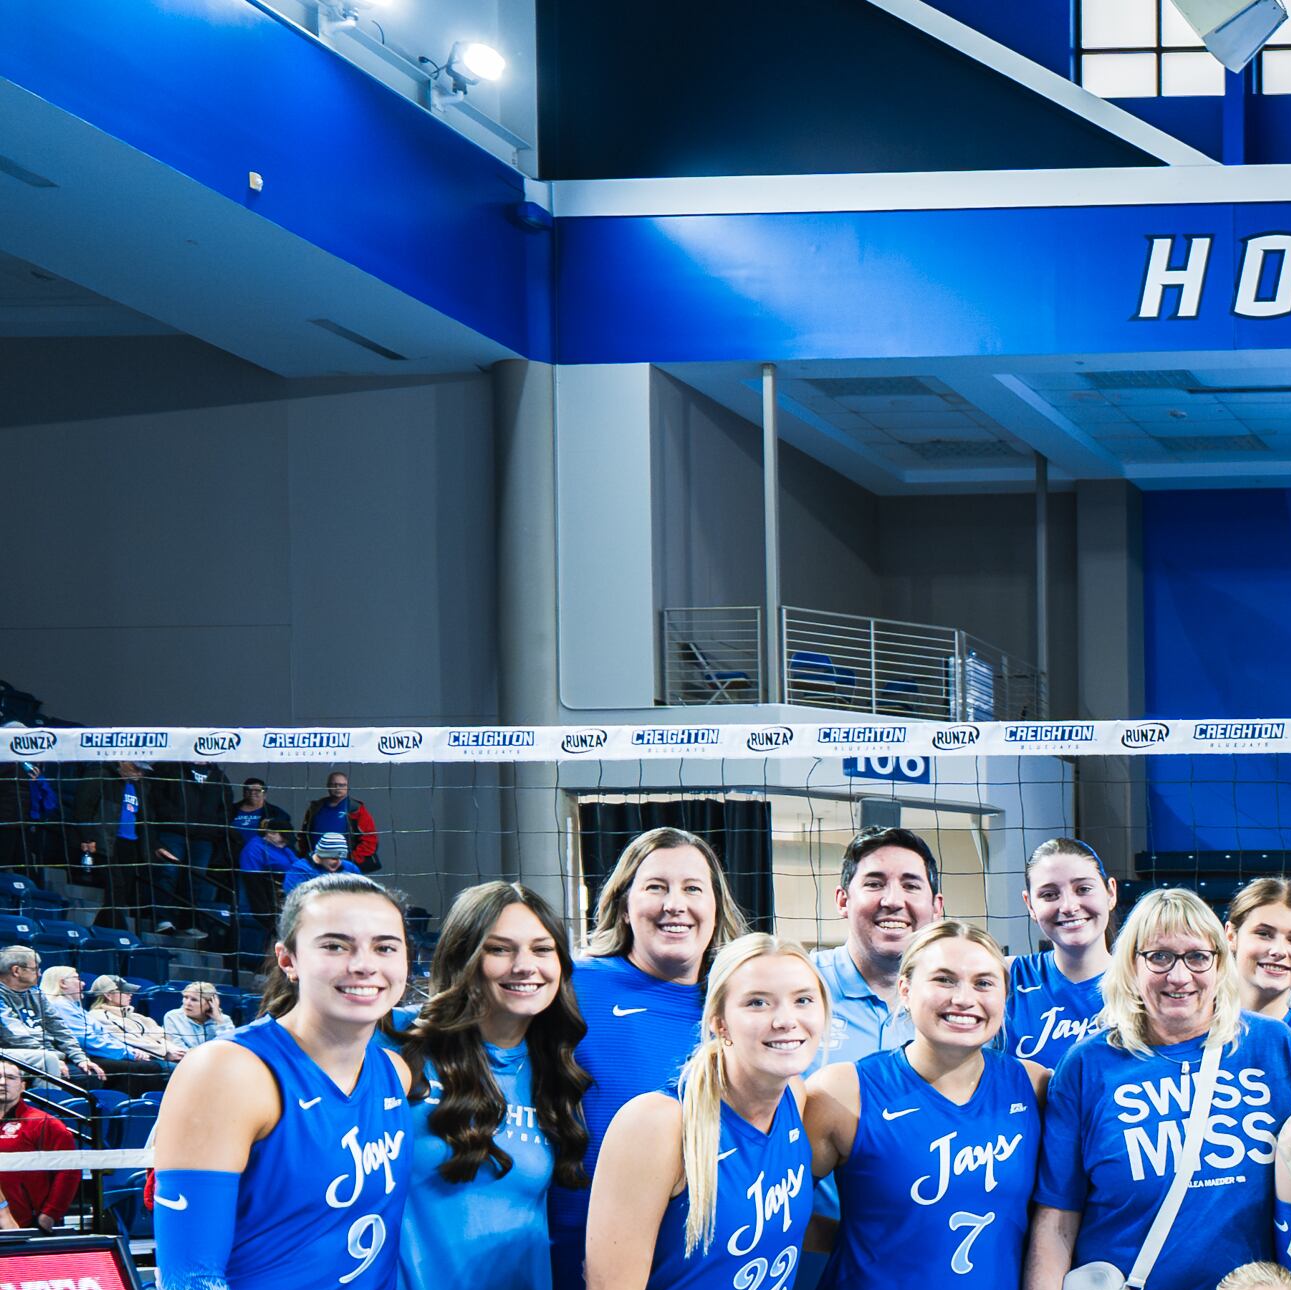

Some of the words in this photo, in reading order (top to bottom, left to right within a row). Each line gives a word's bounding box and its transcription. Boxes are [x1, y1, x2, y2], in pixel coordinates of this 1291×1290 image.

[263, 731, 350, 746] CREIGHTON
[448, 730, 534, 745] CREIGHTON
[632, 729, 719, 743] CREIGHTON
[818, 727, 906, 742] CREIGHTON
[936, 731, 976, 745] RUNZA
[1005, 726, 1094, 741] CREIGHTON
[1125, 729, 1165, 743] RUNZA
[1193, 724, 1285, 739] CREIGHTON
[14, 734, 53, 749] RUNZA
[80, 732, 168, 747] CREIGHTON
[198, 734, 237, 748] RUNZA
[382, 734, 418, 748] RUNZA
[565, 733, 603, 747] RUNZA
[751, 733, 789, 747] RUNZA
[1016, 1007, 1101, 1058] Jays
[325, 1125, 405, 1208] Jays
[911, 1131, 1023, 1205] Jays
[1205, 1177, 1235, 1187] MAEDER
[727, 1164, 805, 1257] Jays
[339, 1214, 387, 1284] 9
[949, 1211, 996, 1275] 7
